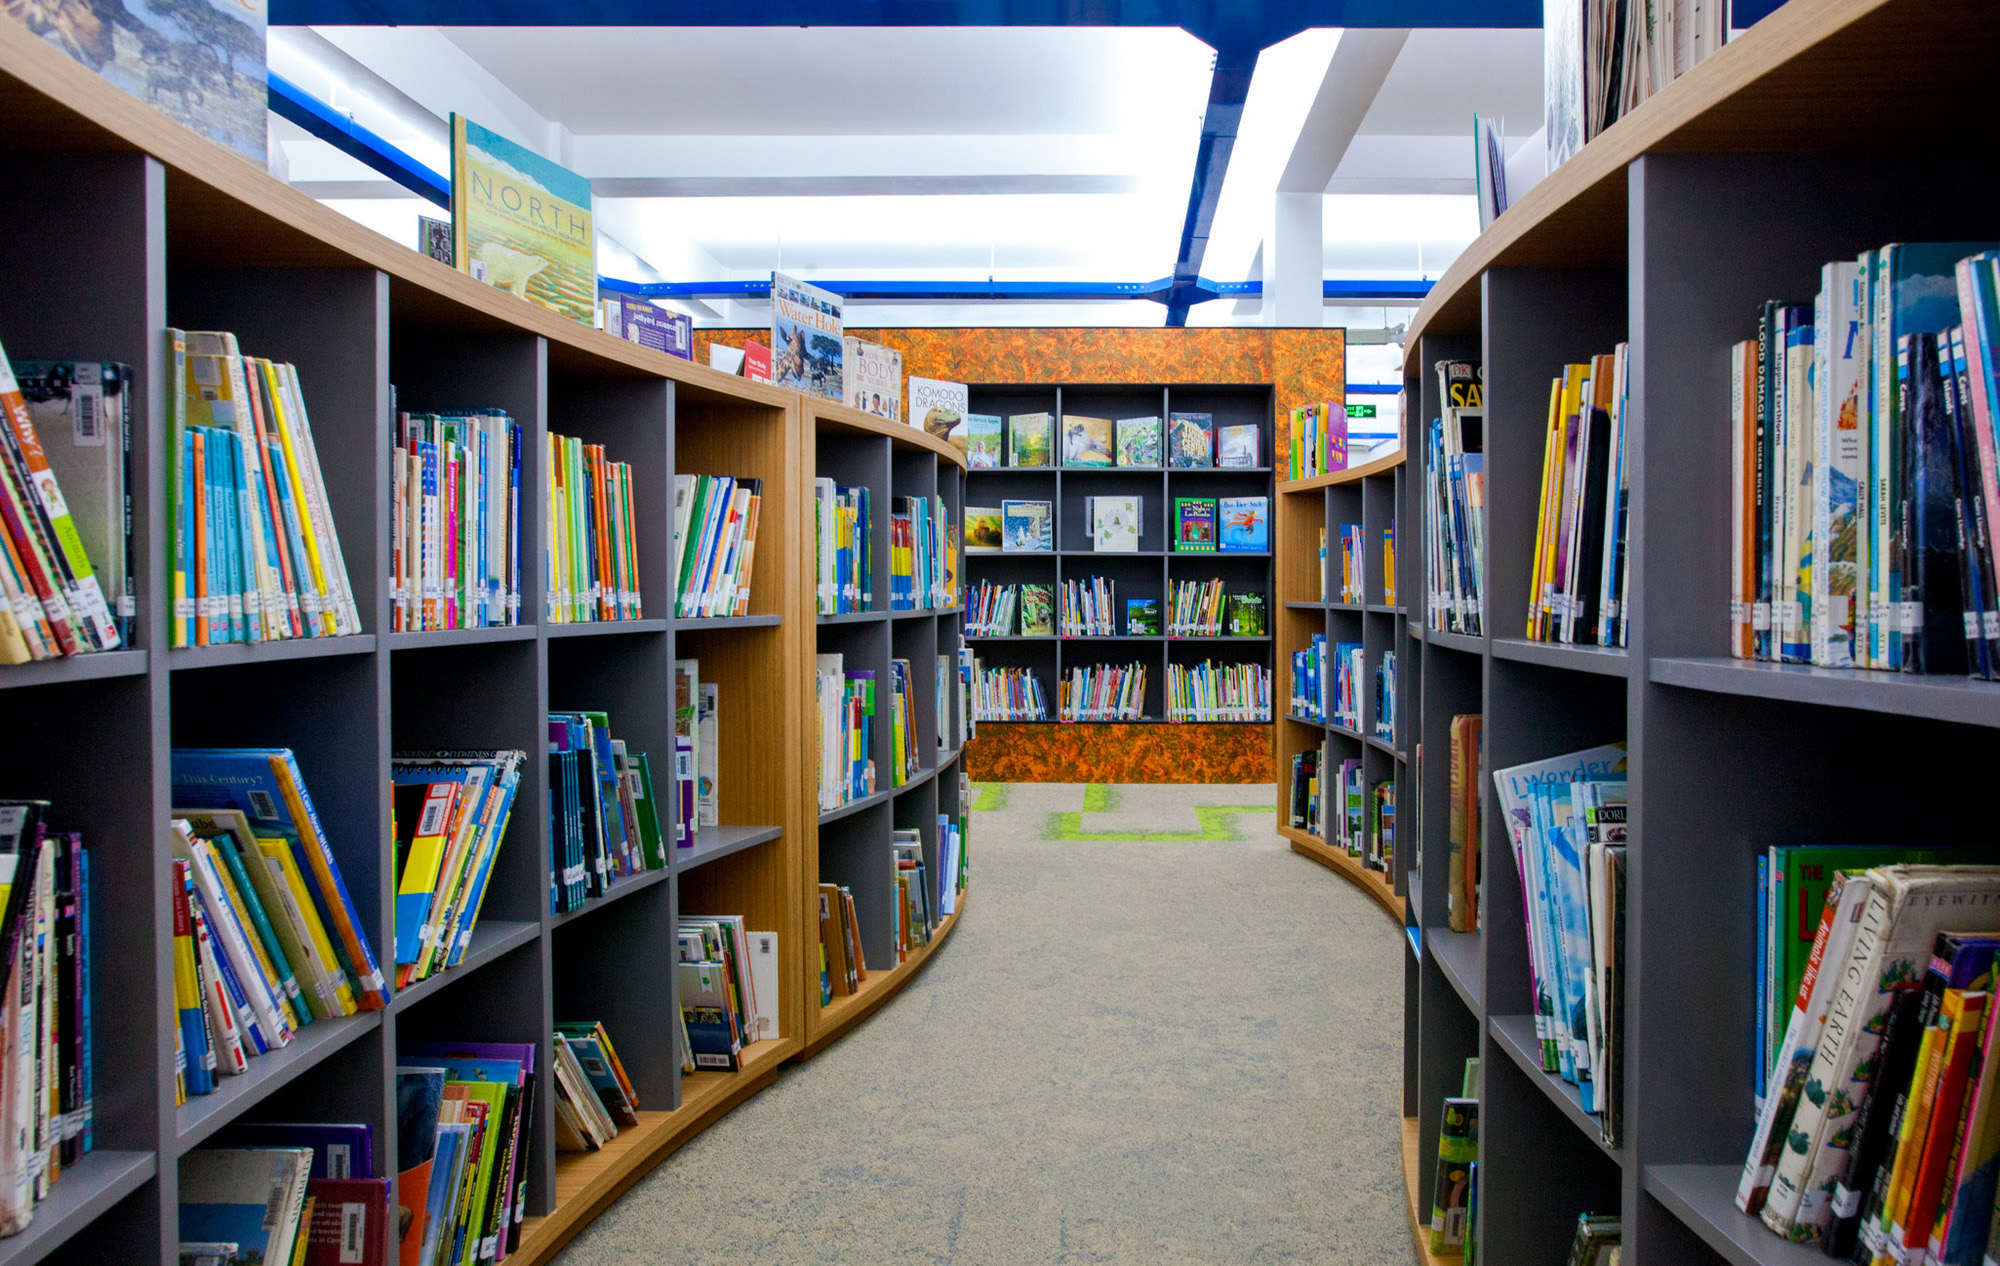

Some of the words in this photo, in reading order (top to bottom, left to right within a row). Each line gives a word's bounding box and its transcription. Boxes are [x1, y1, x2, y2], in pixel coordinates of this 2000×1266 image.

[472, 170, 585, 240] NORTH
[778, 299, 814, 324] Water
[815, 311, 842, 336] Hole
[1758, 316, 1766, 362] FLOOD
[859, 357, 896, 382] BODY
[1452, 366, 1468, 376] DK
[1774, 352, 1783, 392] Mapping
[916, 385, 965, 402] KOMODO
[1757, 365, 1765, 422] DAMAGE
[1899, 383, 1908, 412] Caves
[1943, 378, 1954, 415] Islands
[1958, 374, 1968, 406] Caves
[915, 396, 966, 414] DRAGONS
[13, 405, 43, 456] Why?
[1820, 435, 1828, 462] HAVE
[1820, 466, 1828, 498] SNOW
[1820, 500, 1828, 516] ON
[1820, 520, 1828, 540] TOP
[182, 774, 208, 784] This
[210, 775, 263, 786] Century?
[1523, 760, 1612, 785] Wonder
[1599, 808, 1627, 820] DORL
[302, 794, 314, 812] Care
[318, 834, 334, 864] SHARKS
[1800, 864, 1823, 880] THE
[1808, 918, 1830, 964] Animals
[1849, 898, 1886, 986] LIVING
[1803, 964, 1819, 986] like
[1798, 984, 1810, 1001] us
[1820, 989, 1852, 1067] EARTH
